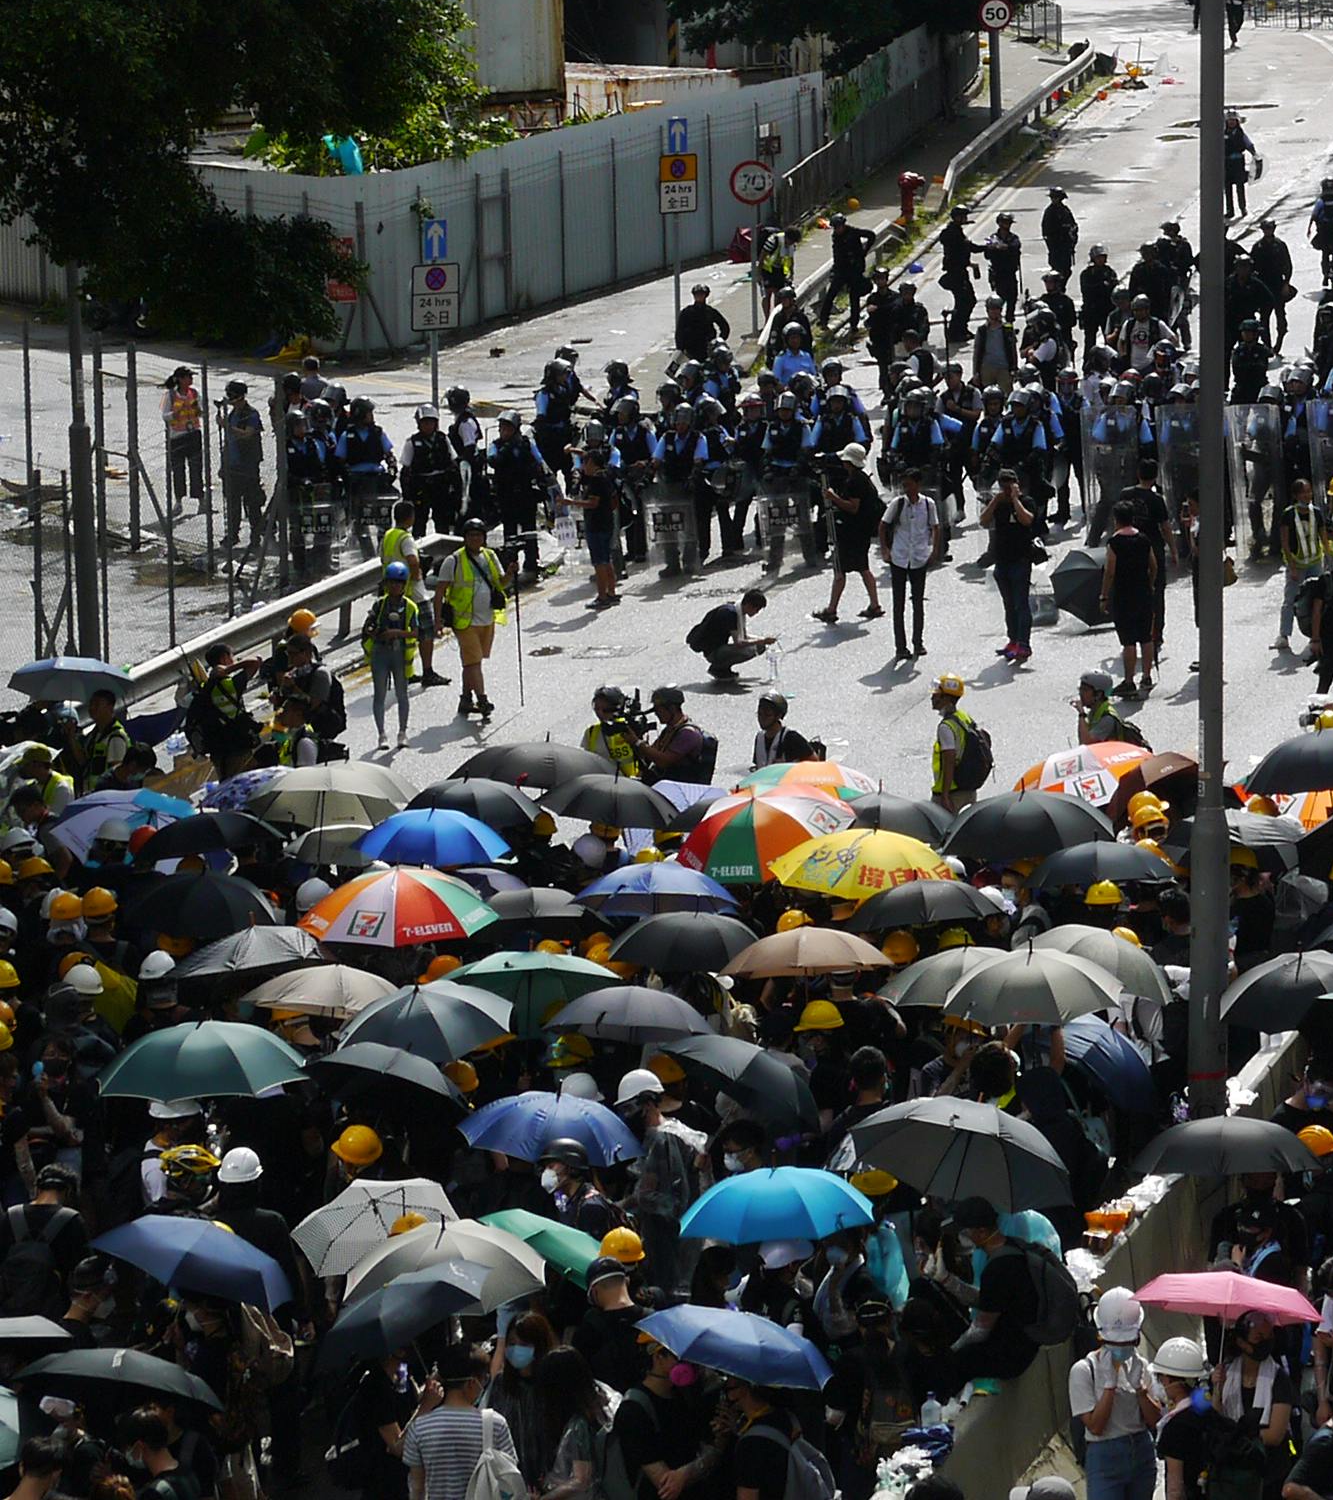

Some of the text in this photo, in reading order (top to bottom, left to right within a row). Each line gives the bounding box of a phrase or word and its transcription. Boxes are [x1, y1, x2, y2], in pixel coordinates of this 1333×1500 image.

[985, 7, 1007, 20] 50
[664, 183, 692, 195] 24 hrs
[667, 197, 690, 210] 全日
[419, 297, 452, 308] 24 hrs
[422, 310, 450, 326] 全日
[360, 517, 391, 525] POLICE
[770, 517, 800, 525] POLICE
[711, 865, 753, 877] 7-ELEVEN
[402, 922, 453, 937] 7-ELEVEN
